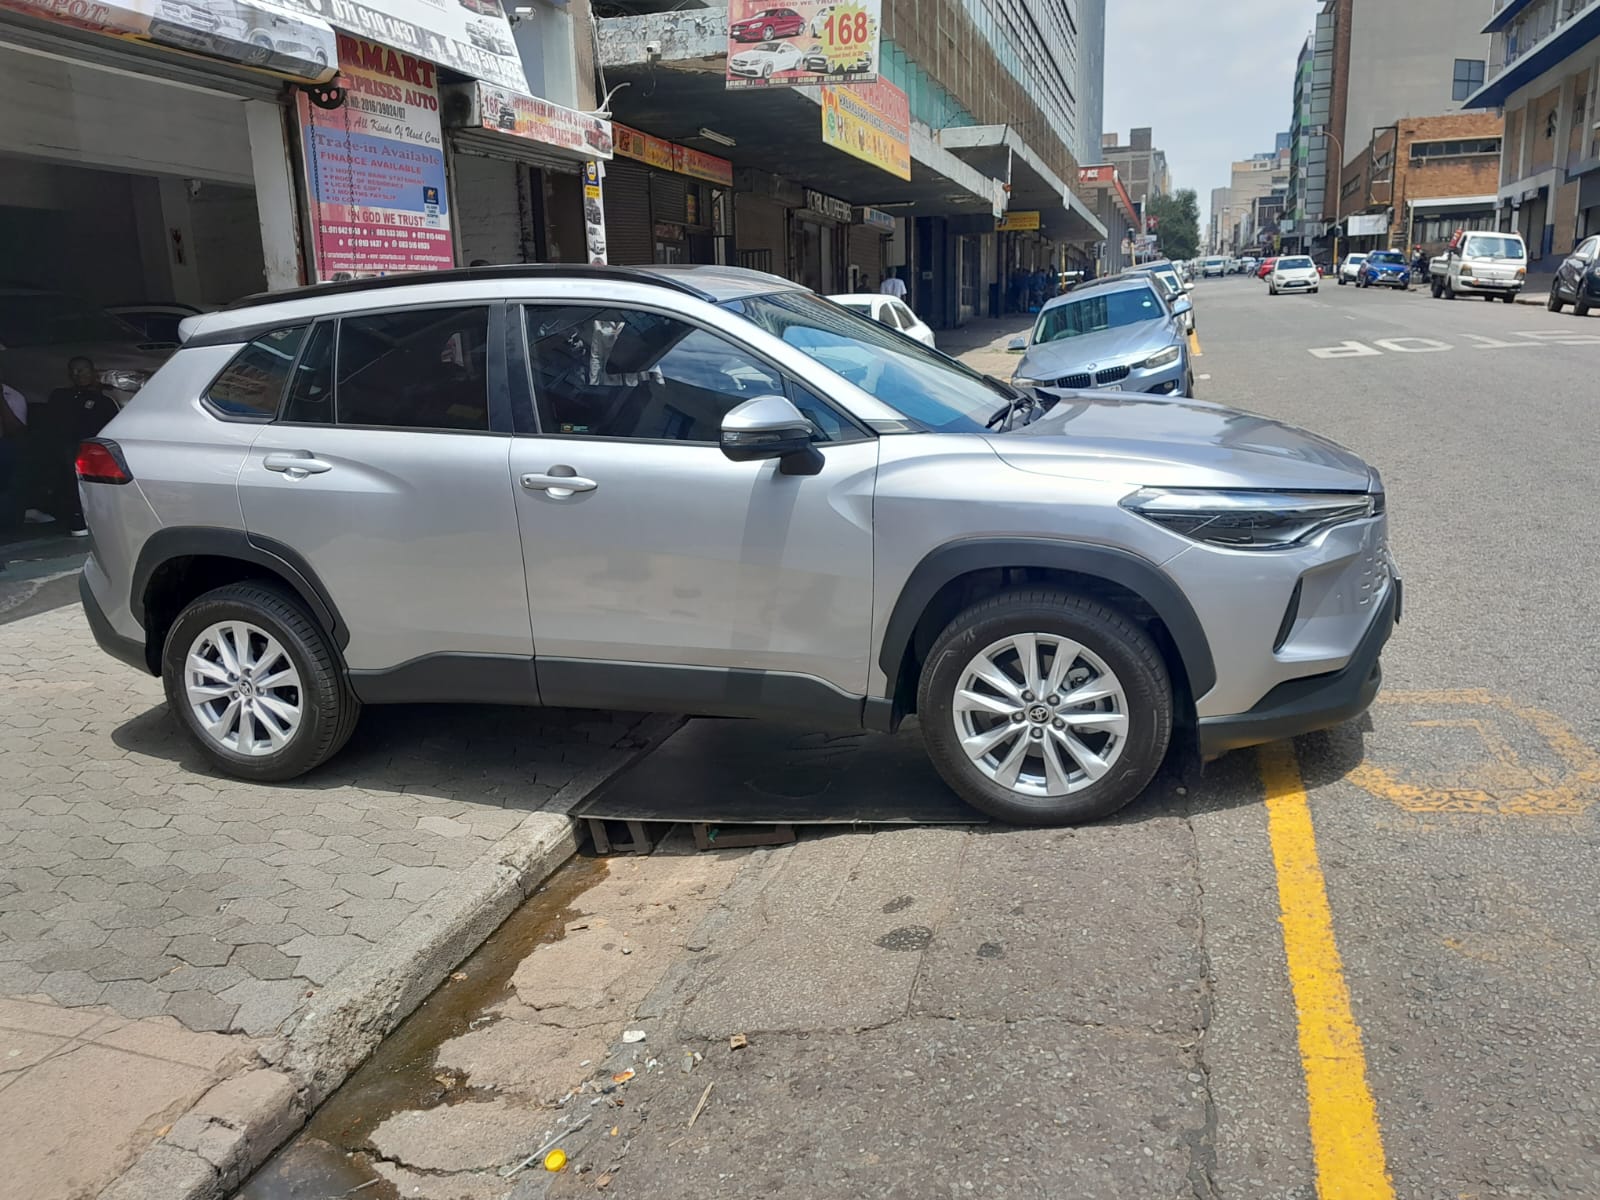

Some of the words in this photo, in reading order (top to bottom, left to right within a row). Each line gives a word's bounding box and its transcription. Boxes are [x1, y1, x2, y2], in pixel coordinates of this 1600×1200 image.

[359, 7, 388, 34] 910
[387, 18, 418, 45] 1437
[824, 12, 868, 46] 168
[339, 34, 435, 89] RMART
[349, 73, 403, 102] RPRISES
[405, 89, 438, 112] AUTO
[354, 117, 368, 127] All
[370, 119, 393, 134] Kinds
[395, 126, 404, 137] Of
[405, 126, 424, 141] Used
[425, 132, 441, 144] Cars
[316, 134, 378, 154] Trade-in
[381, 148, 440, 166] Available
[320, 152, 368, 166] FINANCE
[371, 160, 422, 174] AVAILABLE
[362, 211, 380, 222] GOD
[383, 213, 396, 224] WE
